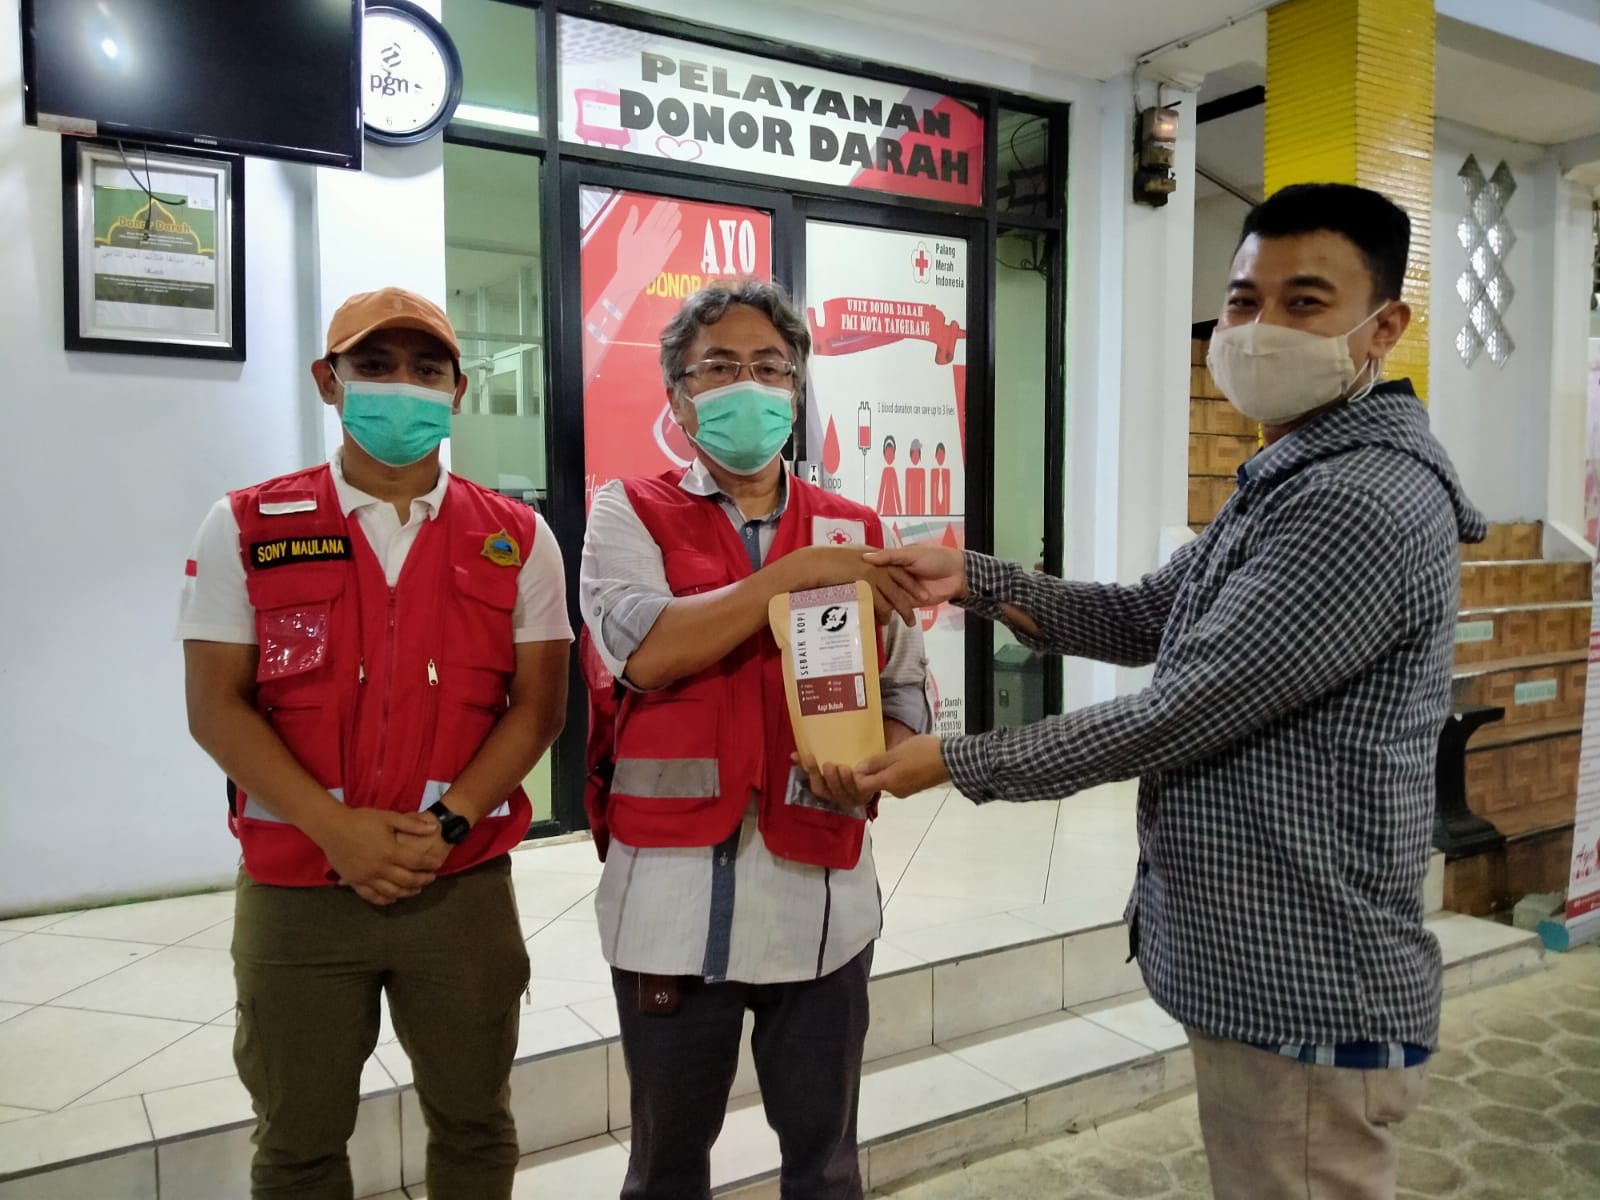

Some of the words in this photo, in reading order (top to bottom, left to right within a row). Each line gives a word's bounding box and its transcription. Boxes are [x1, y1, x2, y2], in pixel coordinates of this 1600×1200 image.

[370, 73, 409, 96] pgn
[641, 51, 950, 138] PELAYANAN
[620, 88, 795, 156] DONOR
[809, 124, 969, 185] DARAH
[701, 217, 756, 275] AYO
[935, 242, 956, 259] Palang
[935, 259, 954, 272] Merah
[935, 274, 964, 289] Indonesia
[847, 299, 868, 312] UNIT
[870, 301, 895, 315] DONOR
[896, 303, 924, 317] DARAH
[841, 314, 858, 331] PMI
[860, 315, 883, 333] KOTA
[885, 318, 930, 336] TANGERANG
[257, 540, 287, 563] SONY
[291, 538, 345, 556] MAULANA
[796, 612, 806, 634] KOPI
[797, 640, 809, 676] SEBAIK
